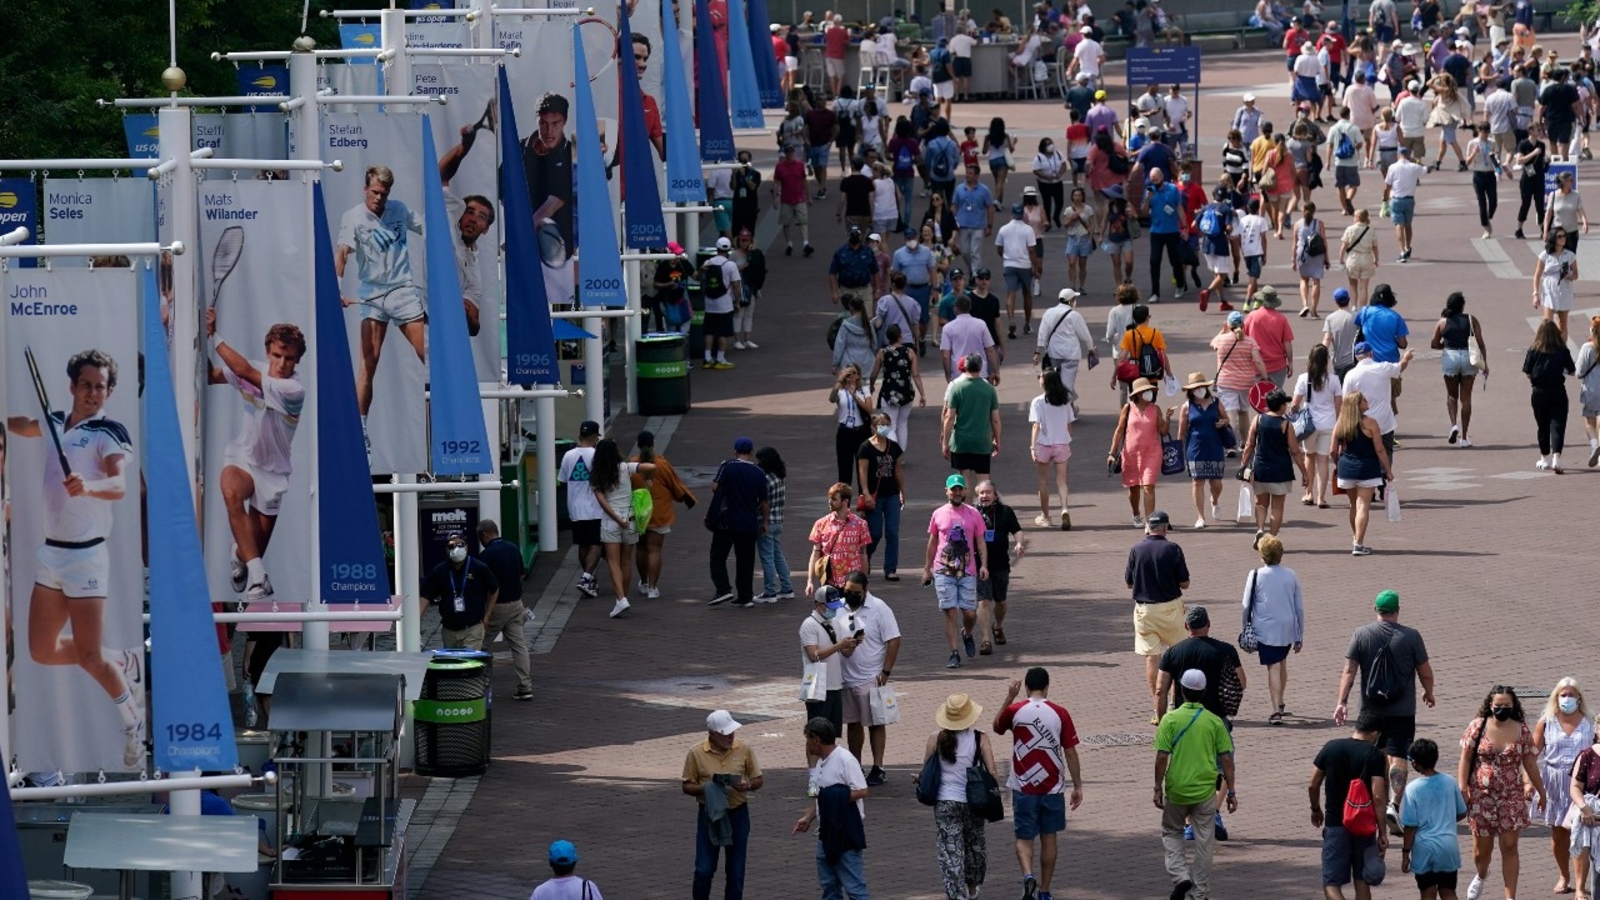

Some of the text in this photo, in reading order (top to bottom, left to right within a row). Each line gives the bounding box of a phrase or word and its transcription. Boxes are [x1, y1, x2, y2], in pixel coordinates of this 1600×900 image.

[500, 31, 523, 40] Marat
[500, 41, 522, 49] Safin
[415, 74, 437, 83] Pete
[415, 86, 459, 95] Sampras
[737, 109, 758, 117] 2016
[196, 125, 225, 136] Steffi
[329, 124, 363, 135] Stefan
[196, 138, 221, 149] Graf
[329, 137, 369, 150] Edberg
[705, 140, 730, 148] 2012
[671, 179, 701, 189] 2008
[49, 192, 92, 205] Monica
[205, 193, 233, 206] Mats
[0, 211, 27, 225] pen
[49, 207, 84, 220] Seles
[205, 208, 258, 221] Wilander
[630, 224, 663, 235] 2004
[584, 279, 620, 290] 2000
[9, 284, 47, 299] John
[10, 301, 78, 316] McEnroe
[515, 353, 550, 366] 1996
[441, 440, 480, 454] 1992
[432, 508, 467, 522] melt
[330, 563, 377, 580] 1988
[331, 582, 376, 592] Champions
[166, 722, 222, 742] 1984
